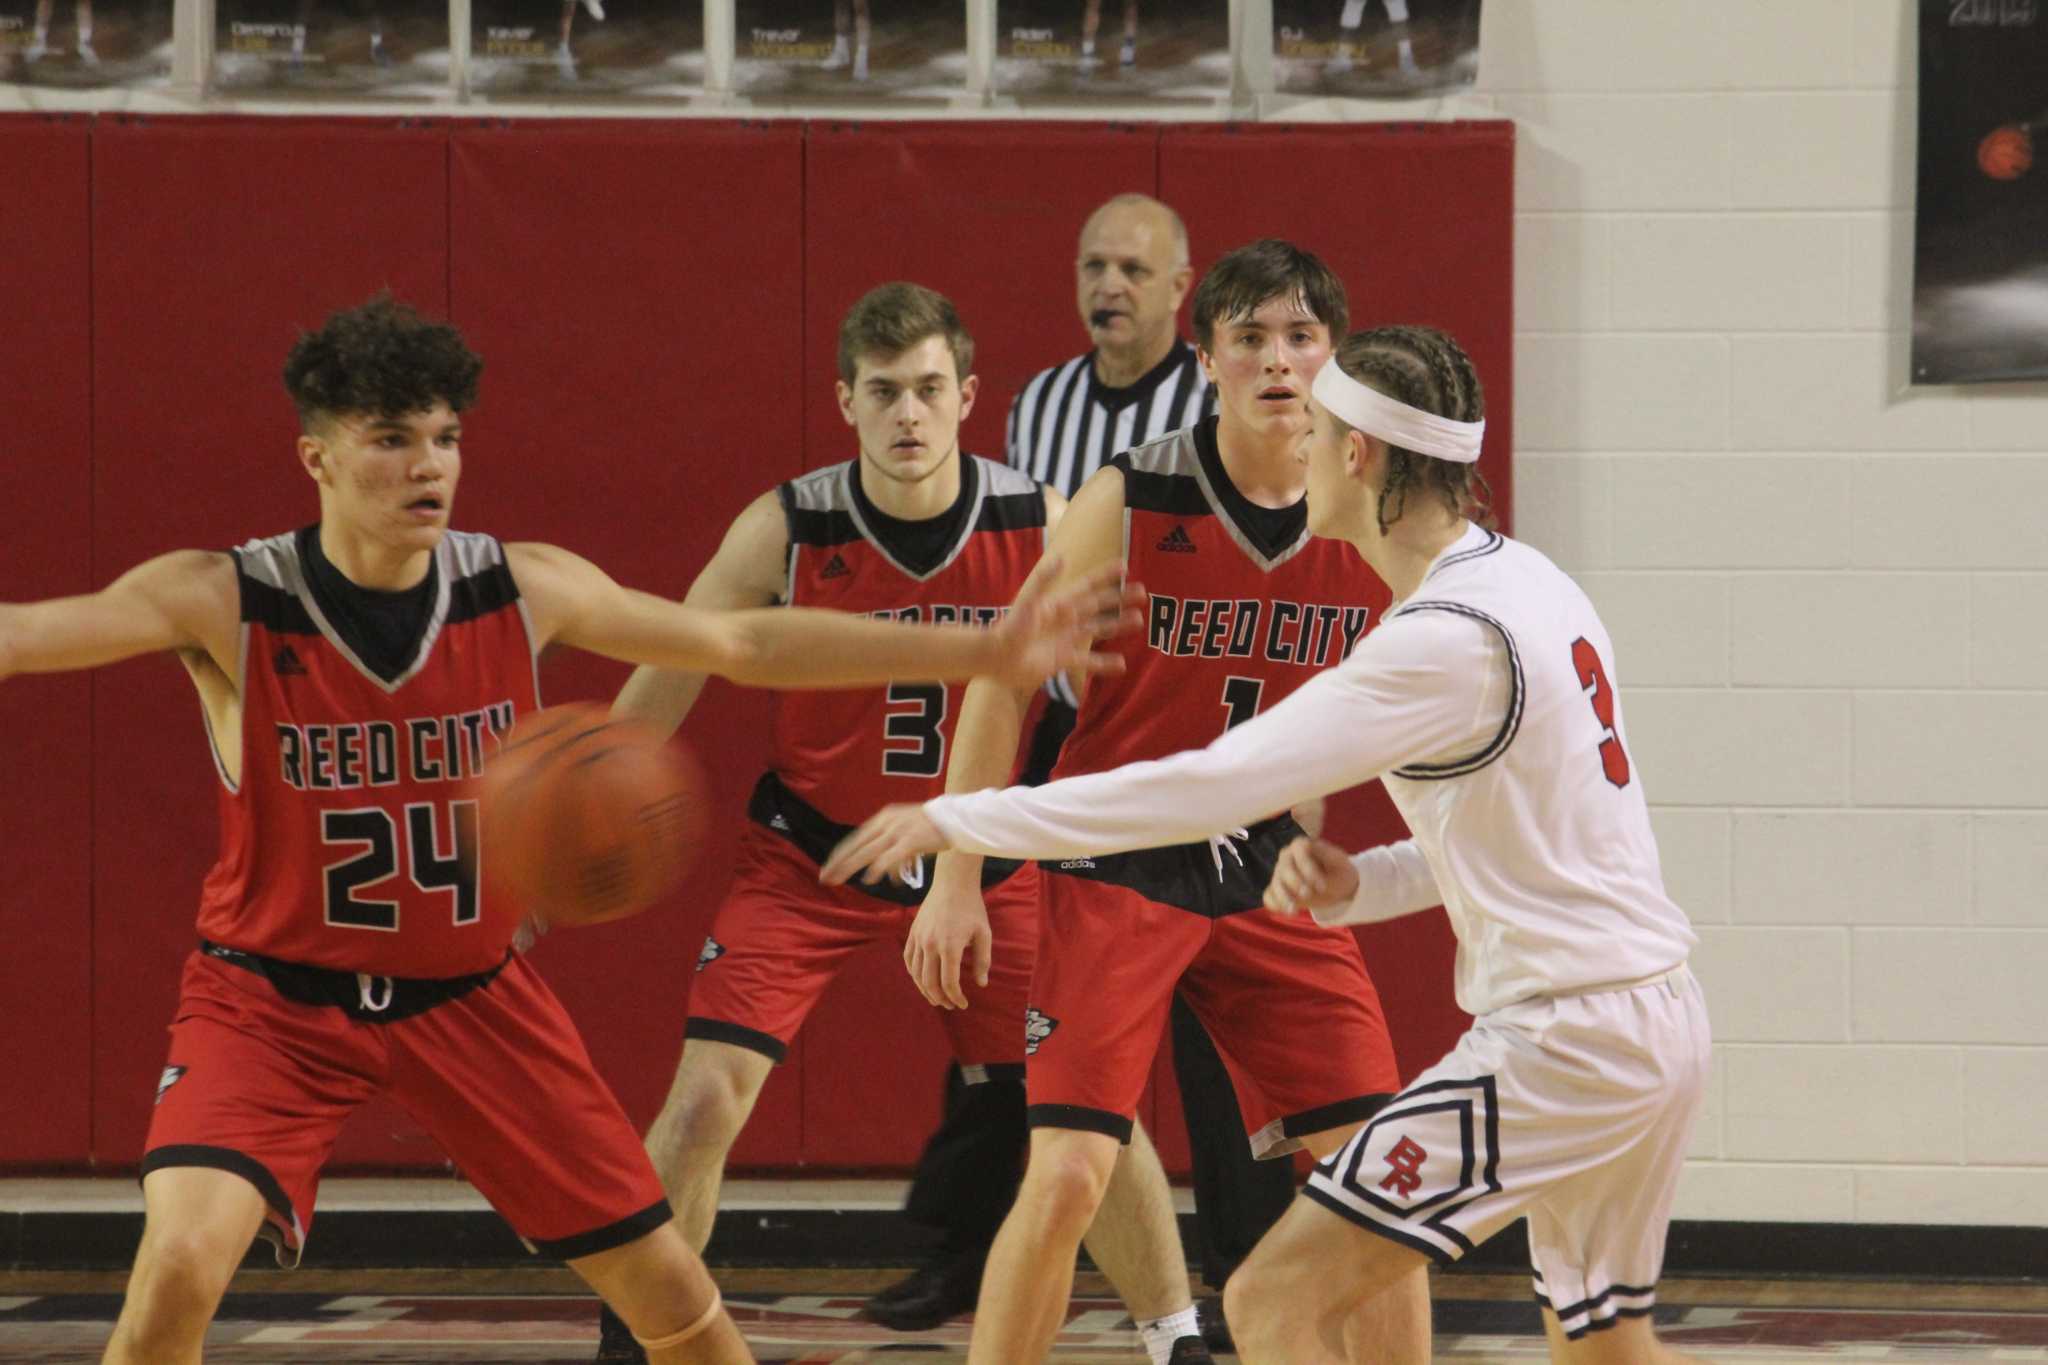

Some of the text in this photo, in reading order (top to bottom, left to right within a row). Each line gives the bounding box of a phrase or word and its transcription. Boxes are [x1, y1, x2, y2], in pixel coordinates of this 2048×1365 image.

[1149, 592, 1368, 667] REED CITY
[276, 721, 399, 790] REED
[882, 680, 947, 778] 3
[1570, 635, 1630, 790] 3
[320, 800, 481, 932] 24
